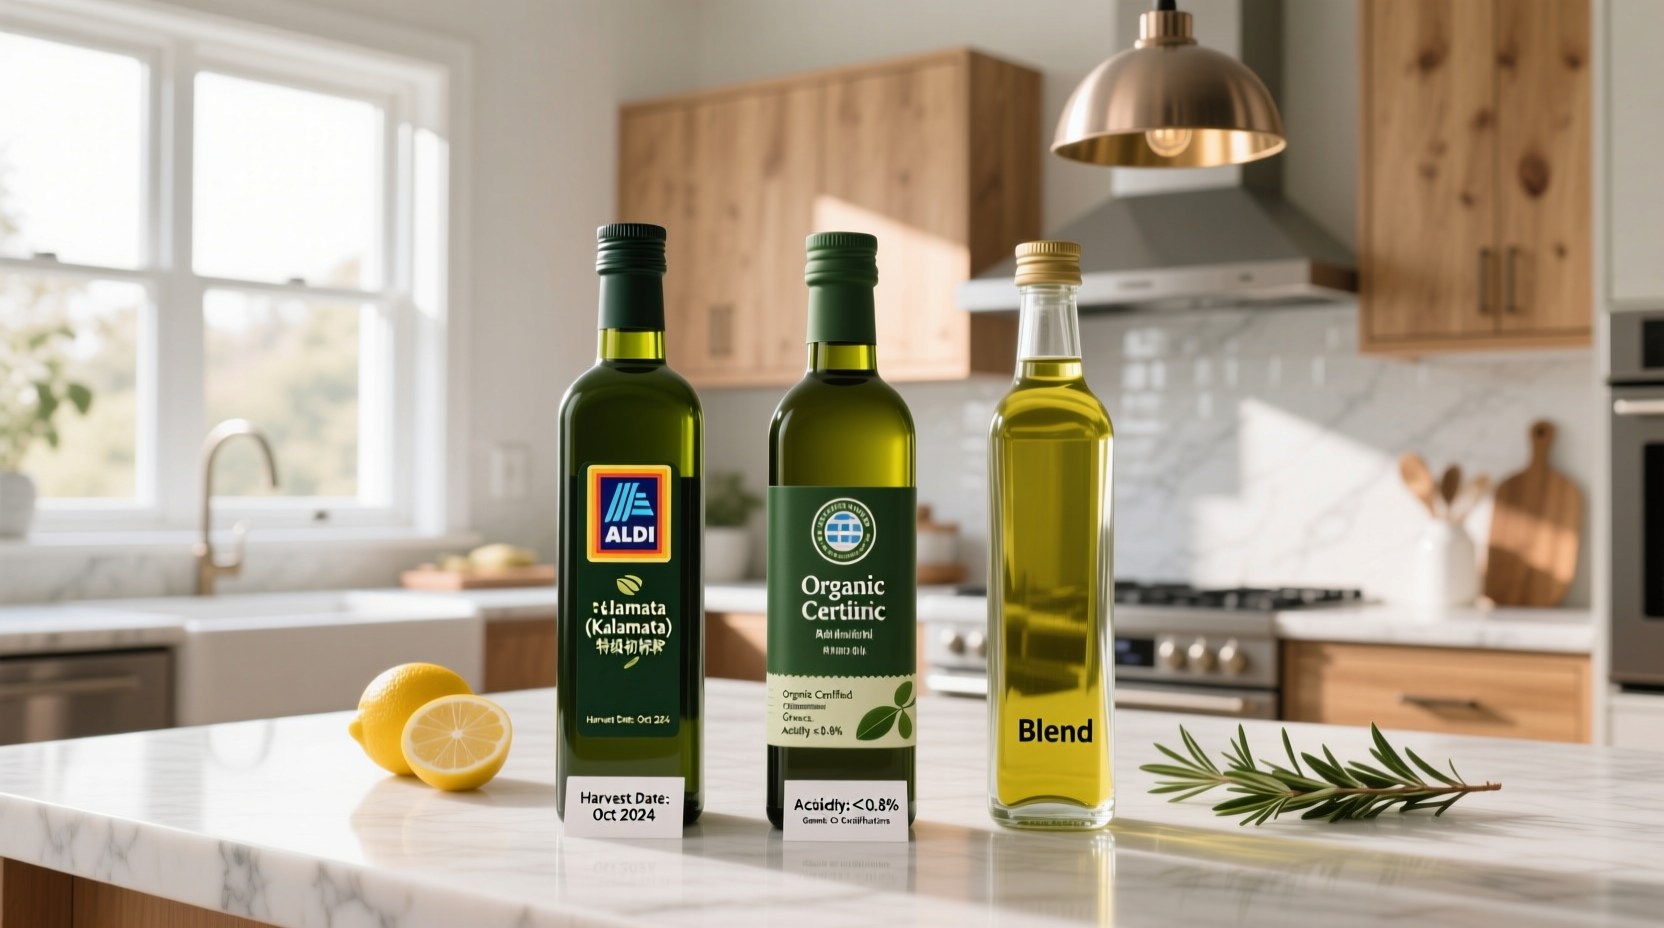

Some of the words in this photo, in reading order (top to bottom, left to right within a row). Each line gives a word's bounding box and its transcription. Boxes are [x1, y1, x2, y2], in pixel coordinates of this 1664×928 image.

[605, 526, 655, 543] ALDI
[801, 574, 885, 601] Organic
[586, 617, 672, 638] (Kalamata)
[1019, 718, 1093, 743] Blend
[580, 791, 632, 804] Harvest
[635, 792, 670, 804] Date:
[593, 808, 616, 821] Oct
[619, 808, 656, 821] 2024
